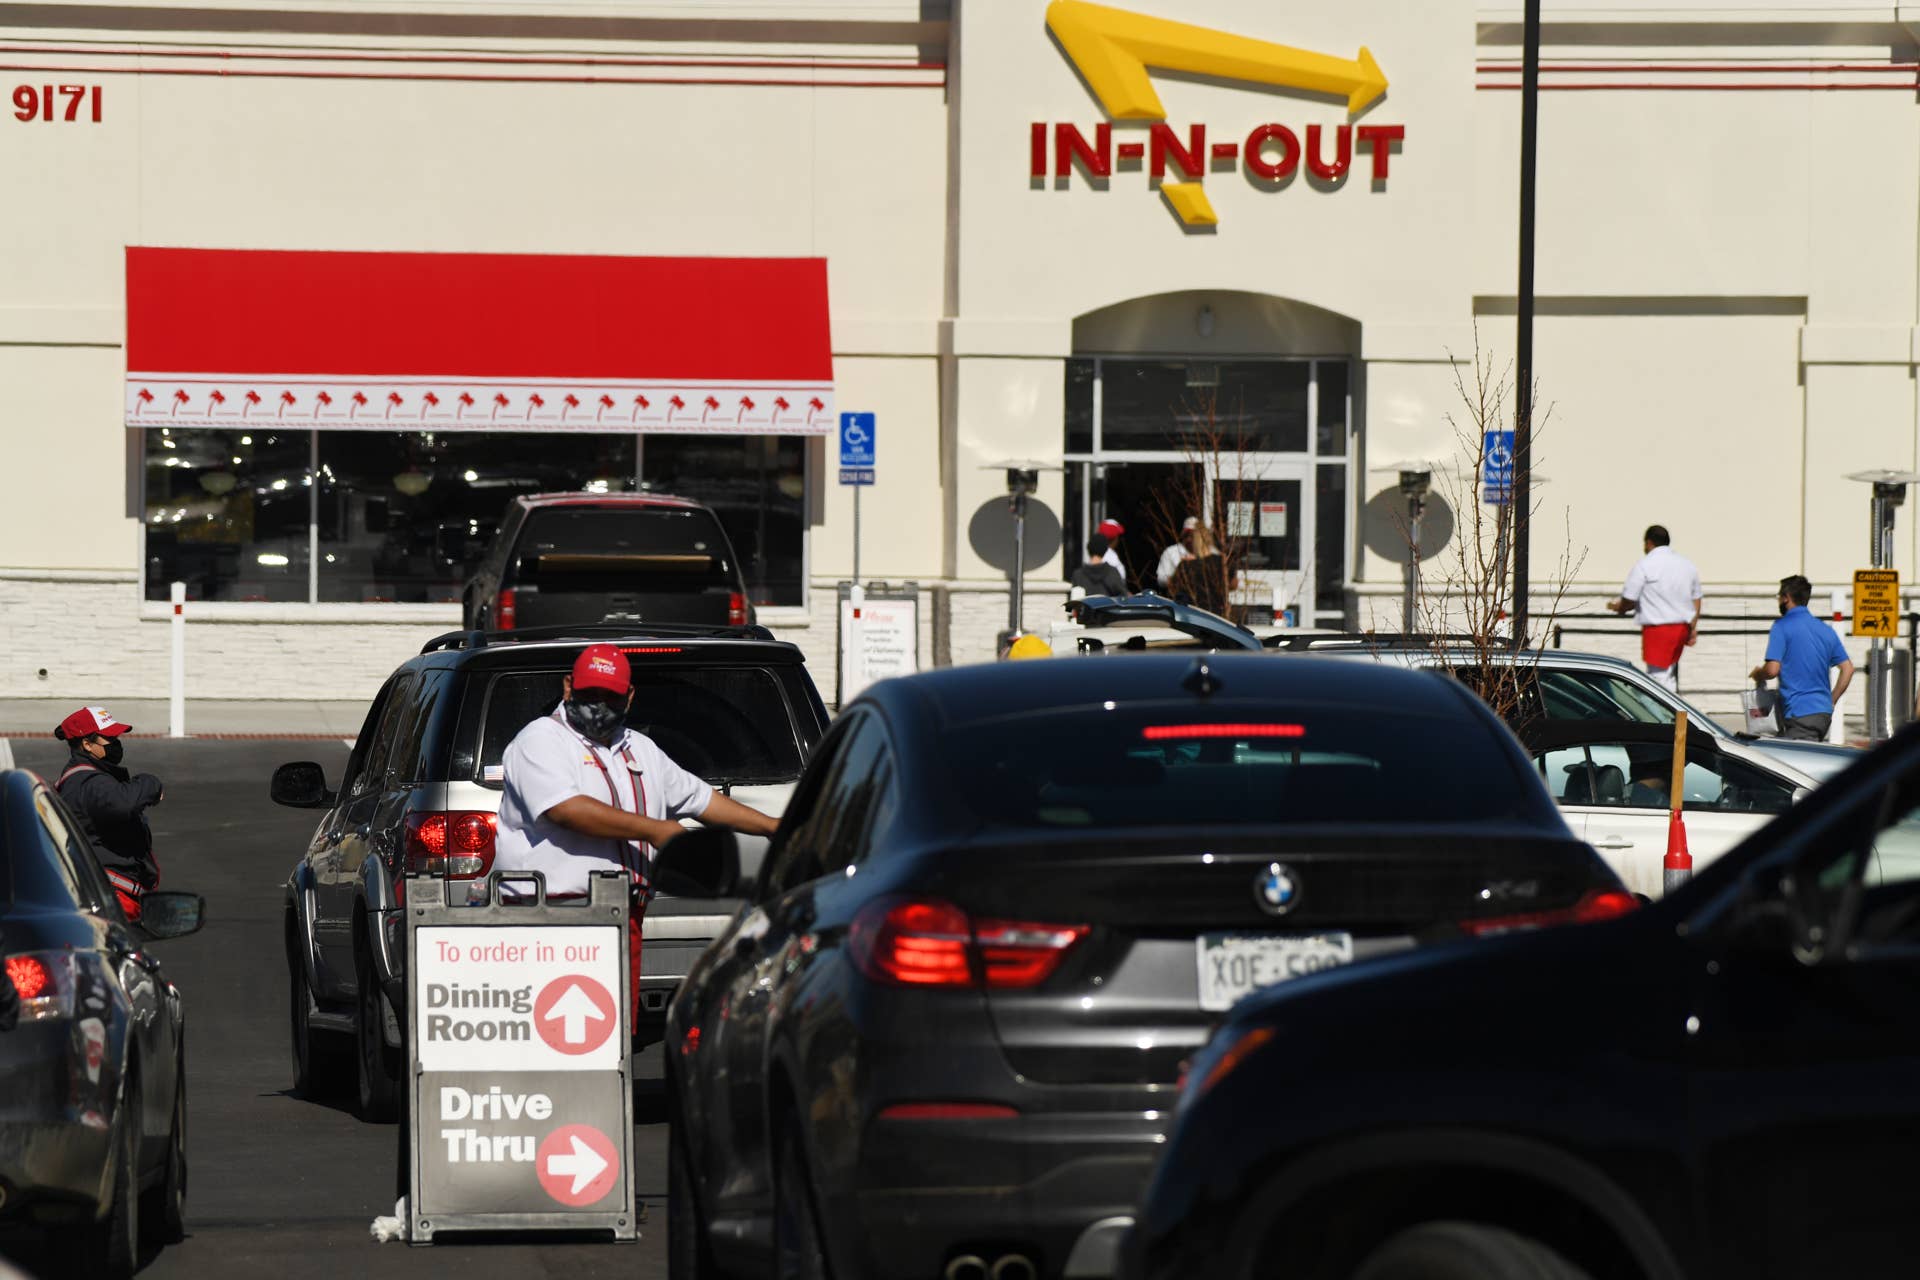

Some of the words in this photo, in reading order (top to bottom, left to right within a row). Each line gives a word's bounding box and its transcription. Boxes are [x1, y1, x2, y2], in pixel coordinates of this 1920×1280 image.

[13, 84, 102, 123] 9171
[1030, 122, 1406, 180] IN-N-OUT
[1858, 573, 1895, 581] CAUTION
[435, 941, 461, 962] To
[469, 941, 529, 963] order
[535, 941, 555, 962] in
[564, 945, 601, 963] our
[426, 983, 533, 1014] Dining
[427, 1014, 531, 1042] Room
[440, 1086, 553, 1121] Drive
[441, 1129, 536, 1162] Thru
